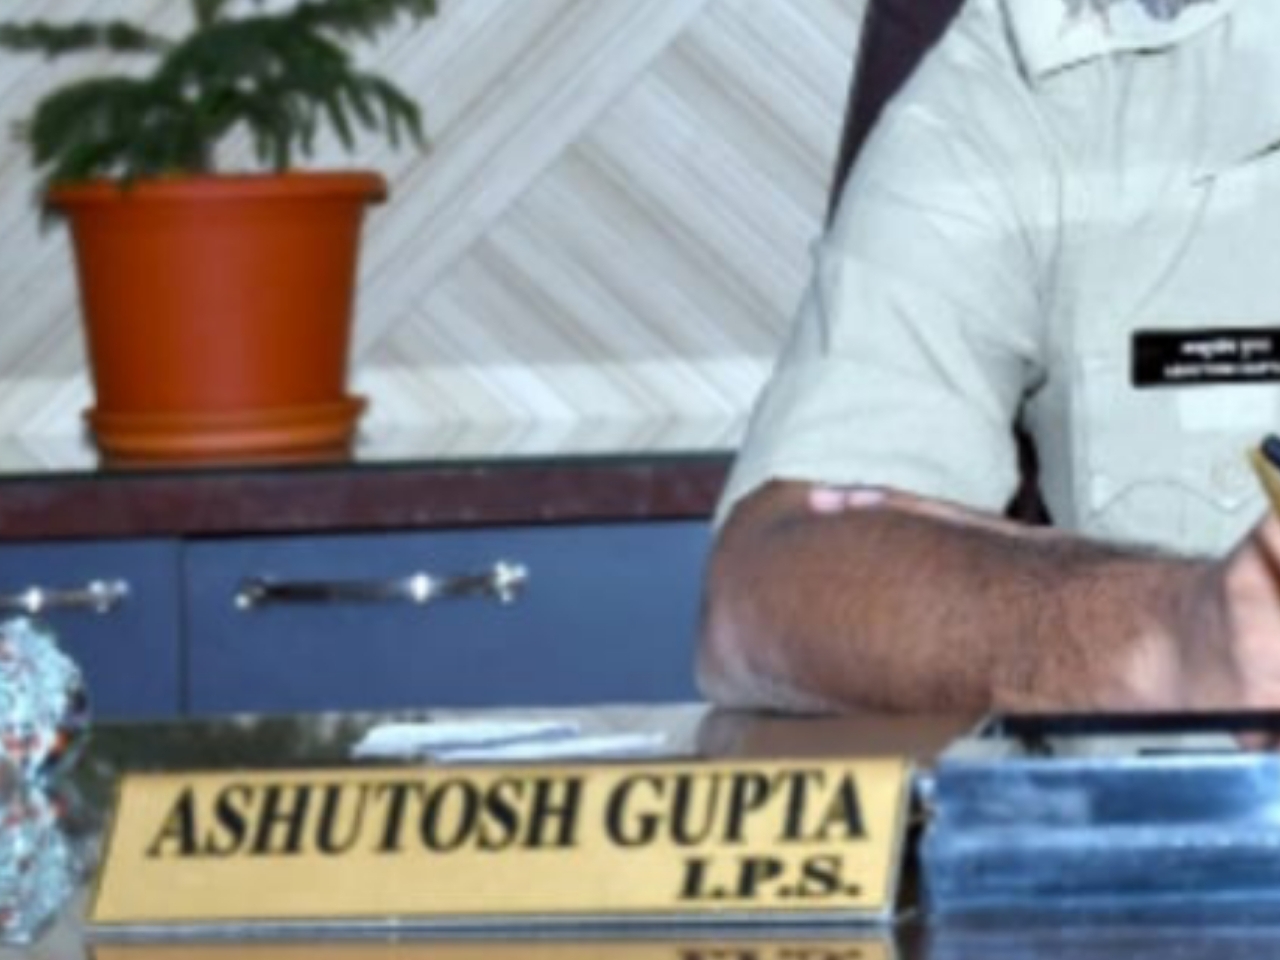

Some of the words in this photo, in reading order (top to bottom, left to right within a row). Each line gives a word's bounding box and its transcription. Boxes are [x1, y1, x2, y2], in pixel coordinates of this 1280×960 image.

[146, 775, 583, 856] ASHUTOSH
[603, 769, 867, 846] GUPTA
[677, 856, 862, 900] I.P.S.
